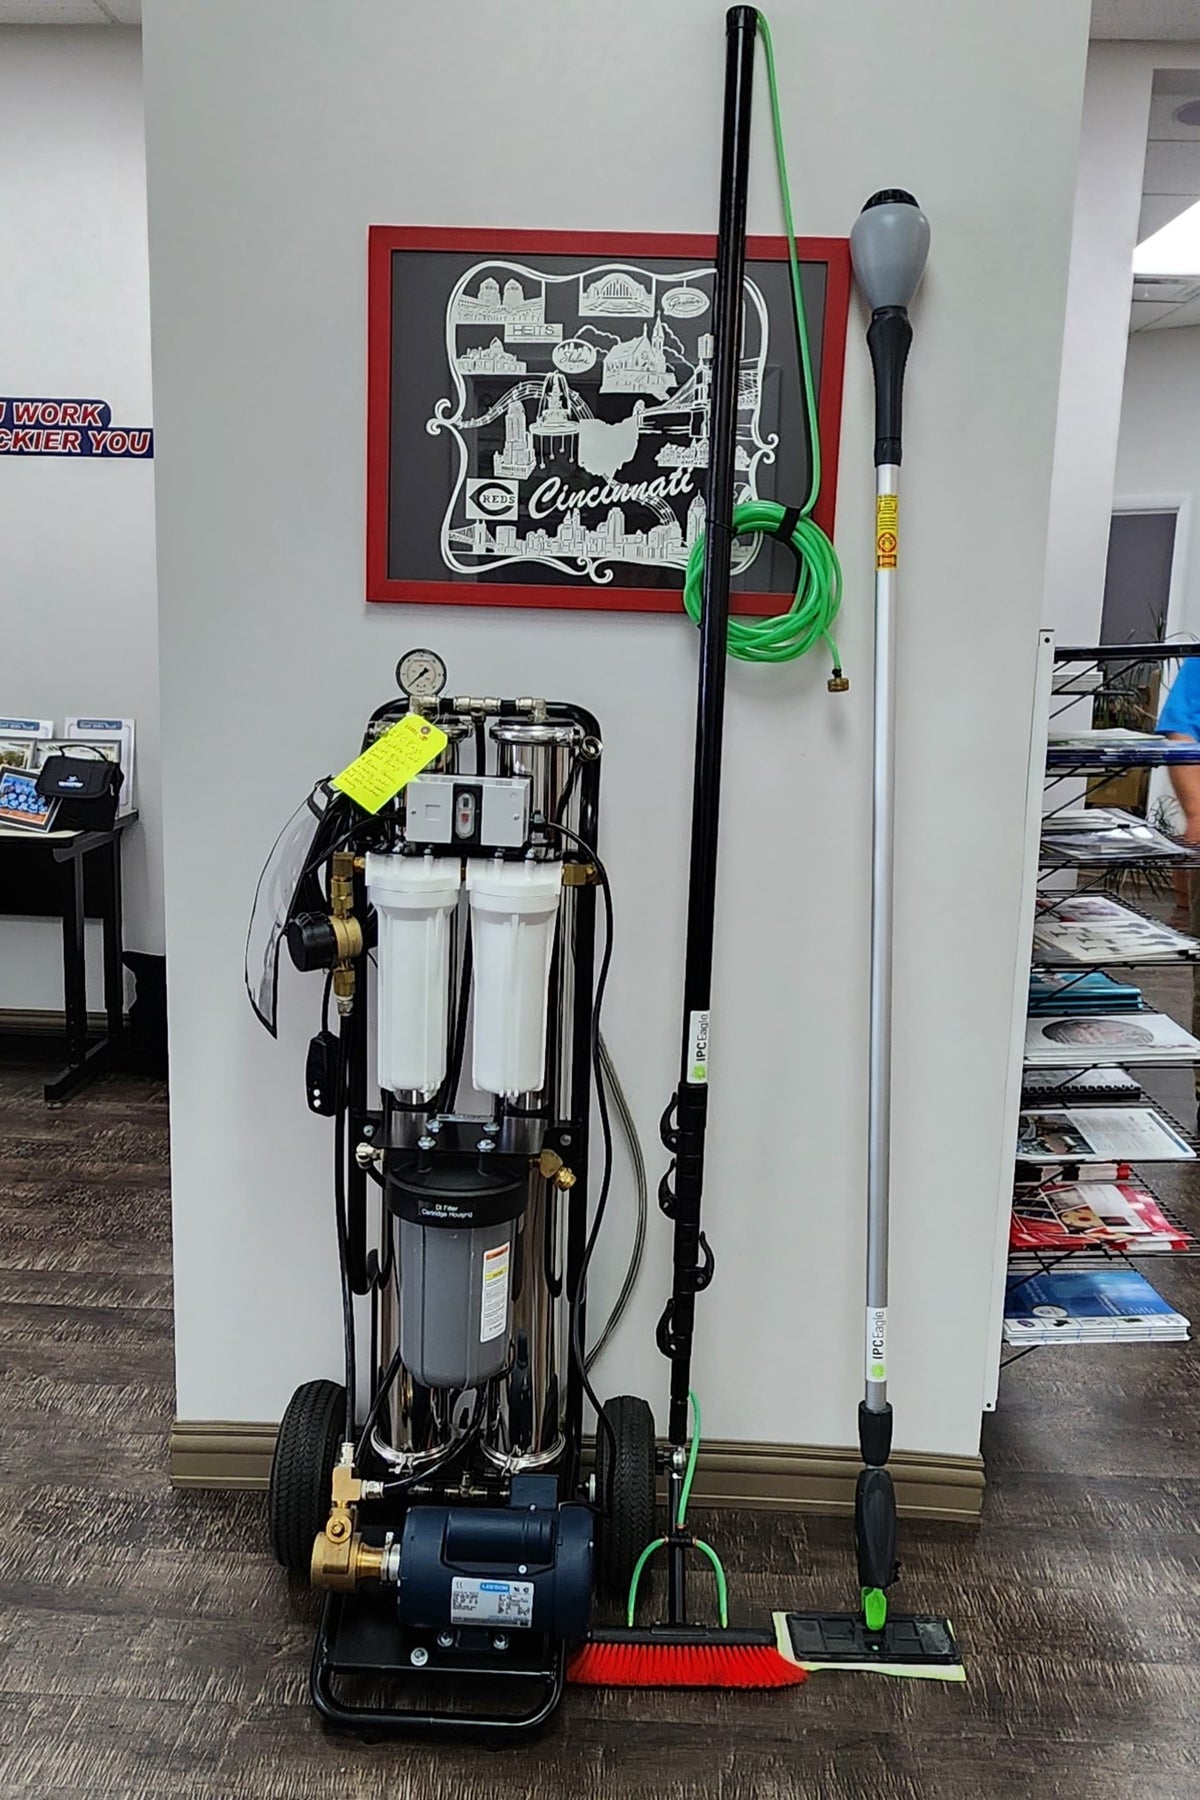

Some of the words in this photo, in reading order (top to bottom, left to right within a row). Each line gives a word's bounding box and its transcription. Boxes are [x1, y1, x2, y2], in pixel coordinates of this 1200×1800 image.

[13, 402, 105, 425] WORK
[88, 431, 151, 454] YOU
[482, 494, 516, 505] REDS
[527, 466, 695, 519] Cincinnati
[695, 1041, 707, 1062] IPC
[872, 1311, 886, 1338] Eagle
[872, 1339, 884, 1360] IPC
